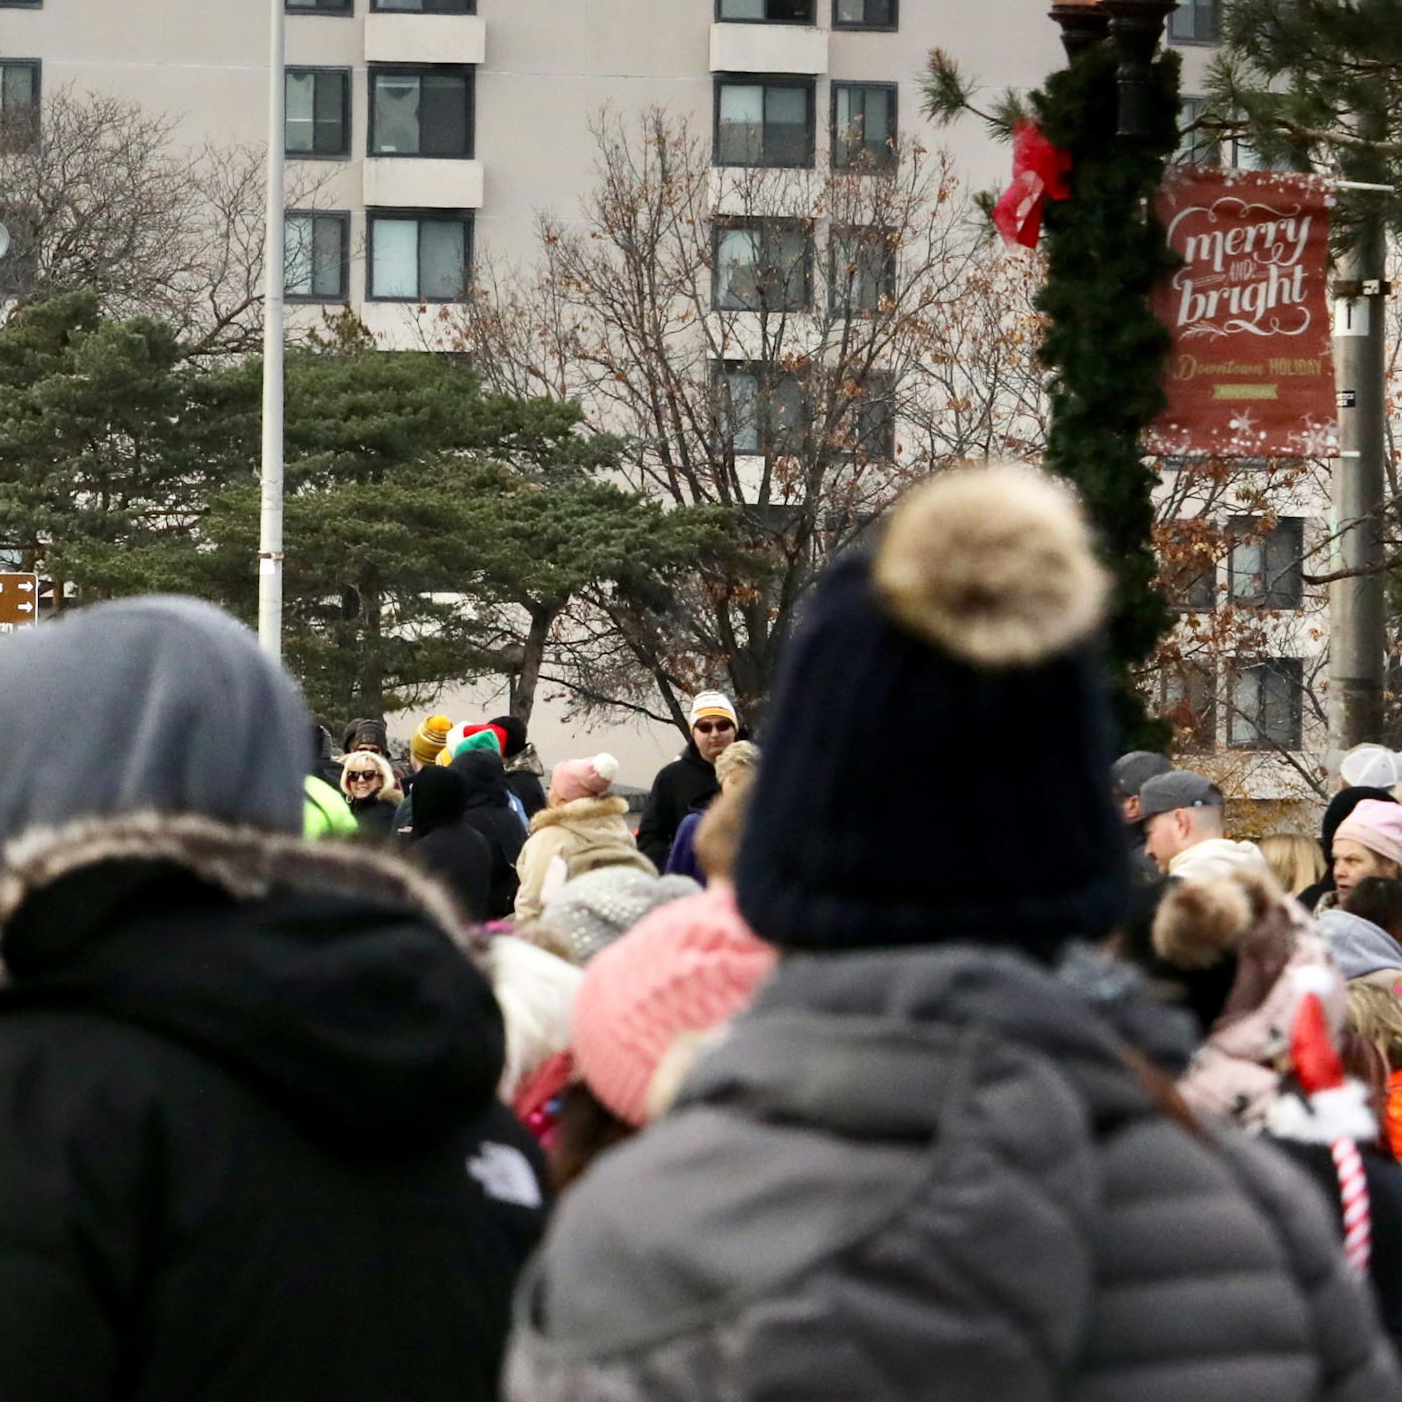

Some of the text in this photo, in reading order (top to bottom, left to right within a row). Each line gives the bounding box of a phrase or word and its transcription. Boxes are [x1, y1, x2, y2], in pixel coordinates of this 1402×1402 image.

[1184, 215, 1313, 273] merry
[1175, 264, 1308, 328] bright
[1269, 357, 1323, 376] HOLIDAY
